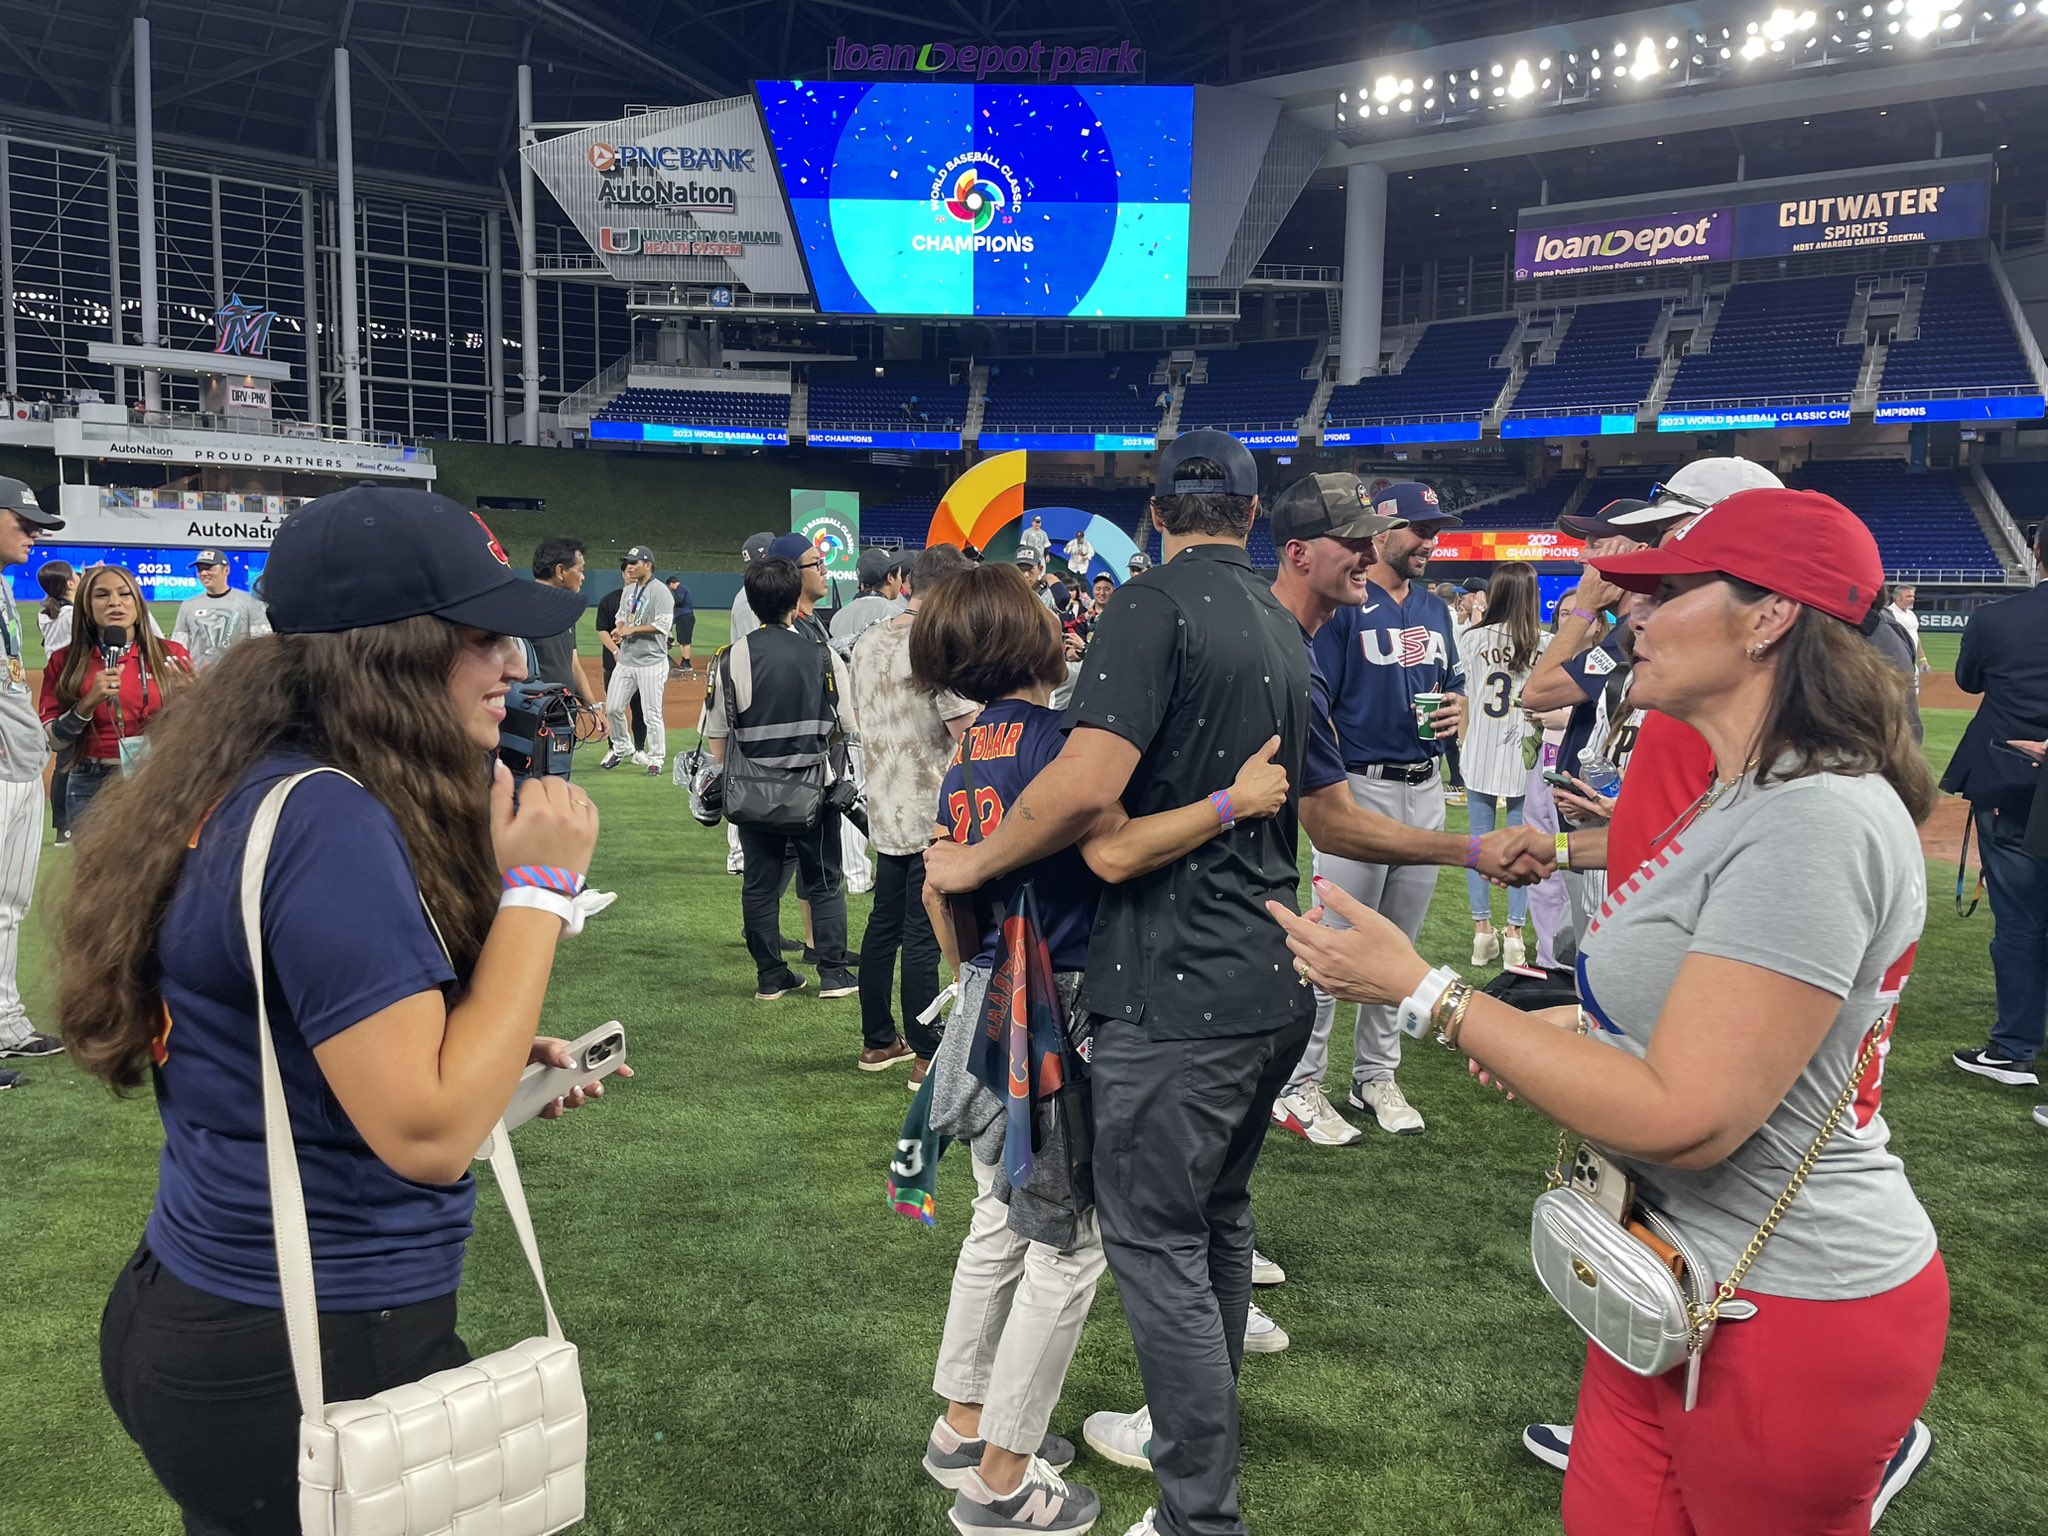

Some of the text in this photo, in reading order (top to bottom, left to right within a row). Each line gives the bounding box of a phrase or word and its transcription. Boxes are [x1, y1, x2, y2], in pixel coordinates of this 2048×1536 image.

[833, 36, 1142, 81] loanDepot park
[930, 151, 1022, 213] WORLD BASEBALL CLASSIC
[598, 180, 734, 204] AutoNation
[1779, 187, 1938, 227] CUTWATER
[643, 228, 780, 244] UNIVERSITY OF MIAMI
[1824, 221, 1889, 240] SPIRITS
[911, 235, 1035, 252] CHAMPIONS
[1534, 217, 1711, 262] loanDepot
[1793, 232, 1926, 252] MOST AWARDED CANNED COCKTAIL
[643, 242, 743, 256] HEALTH SYSTEM
[1533, 269, 1554, 278] Home
[1555, 266, 1589, 276] Purchase
[1592, 263, 1614, 272] Home
[711, 290, 729, 303] 42
[1661, 417, 1685, 427] 2023
[1687, 415, 1723, 426] WORLD
[1725, 413, 1780, 425] BASEBALL
[1782, 411, 1828, 421] CLASSIC
[672, 429, 693, 439] 2023
[693, 430, 724, 440] WORLD
[725, 431, 766, 441] BASEBALL
[824, 434, 873, 444] CHAMPIONS
[1122, 438, 1142, 446] 2023
[1239, 436, 1273, 445] CLASSIC
[110, 443, 174, 456] AutoNation
[195, 450, 342, 468] PROUD PARTNERS
[356, 461, 406, 473] Miami Marlins
[1527, 534, 1558, 546] 2023
[1506, 547, 1580, 558] CHAMPIONS
[138, 563, 172, 574] 2023
[1360, 626, 1448, 671] USA
